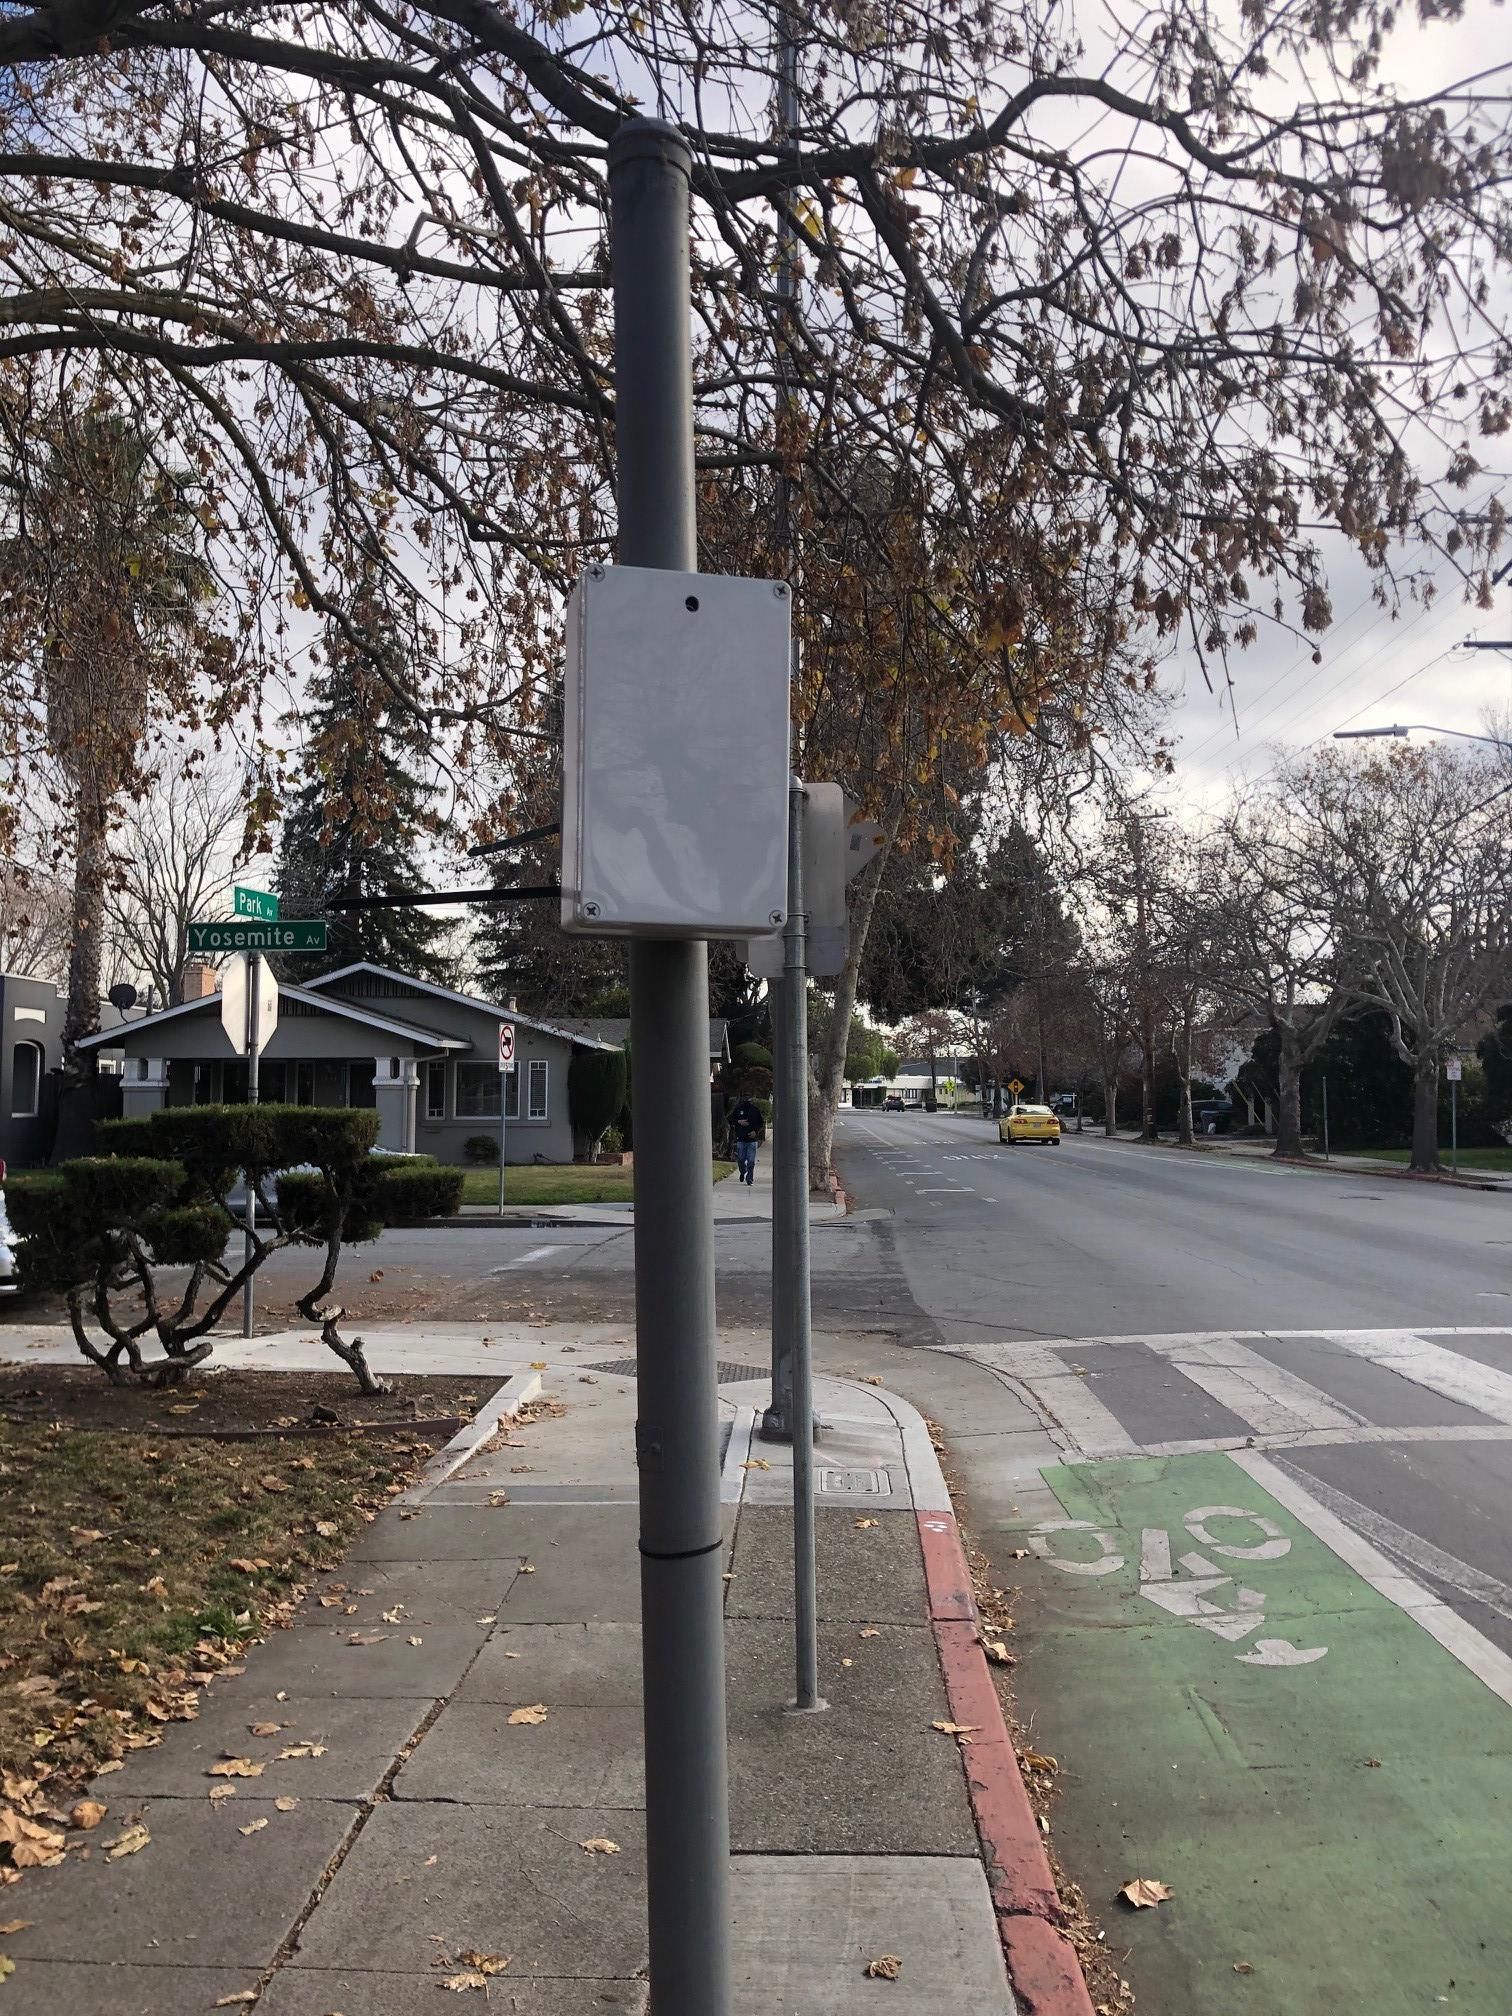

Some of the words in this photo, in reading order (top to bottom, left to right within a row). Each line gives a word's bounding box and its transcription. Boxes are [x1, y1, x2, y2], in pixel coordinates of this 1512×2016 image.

[239, 892, 262, 915] Park
[266, 907, 273, 917] Av
[194, 927, 295, 947] Yosemite
[306, 935, 320, 945] Av
